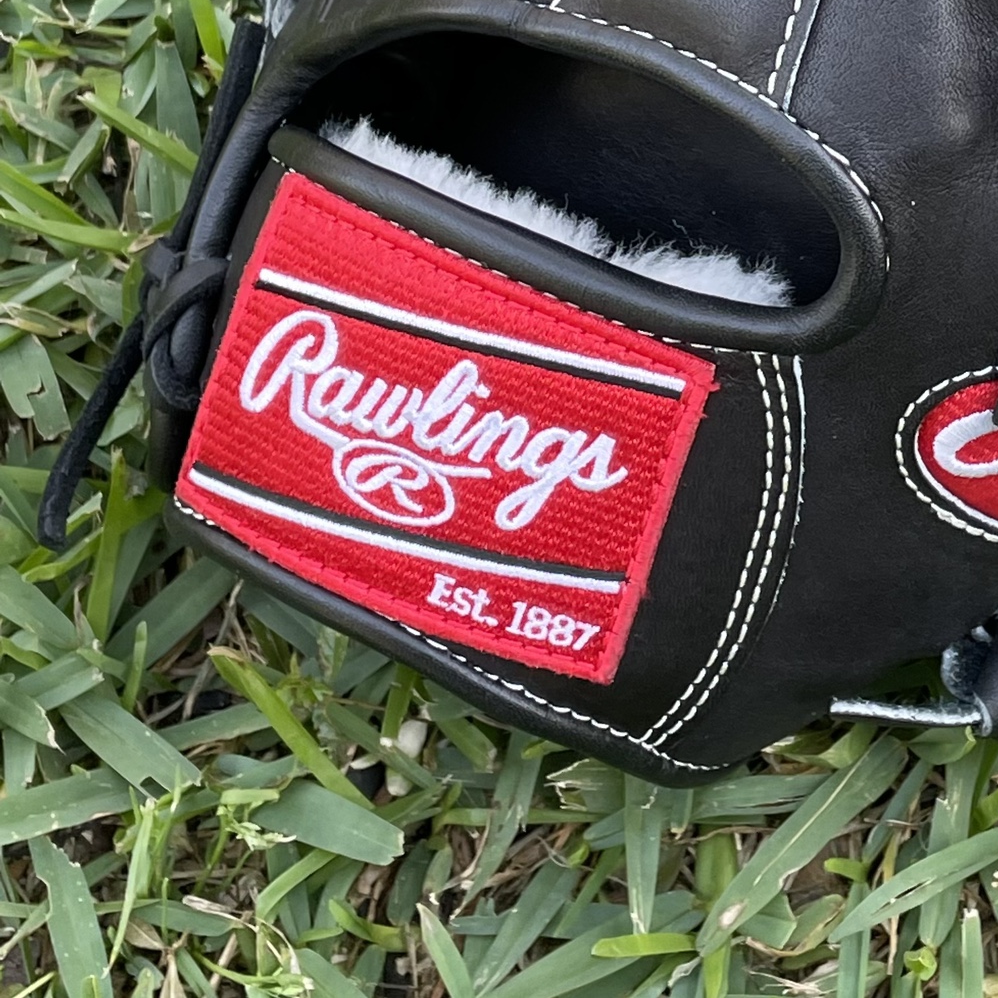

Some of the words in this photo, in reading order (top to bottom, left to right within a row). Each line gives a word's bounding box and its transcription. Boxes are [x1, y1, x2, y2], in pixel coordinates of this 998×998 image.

[239, 309, 629, 530] Rawlings
[427, 573, 499, 627] Est.
[505, 601, 601, 651] 1887
